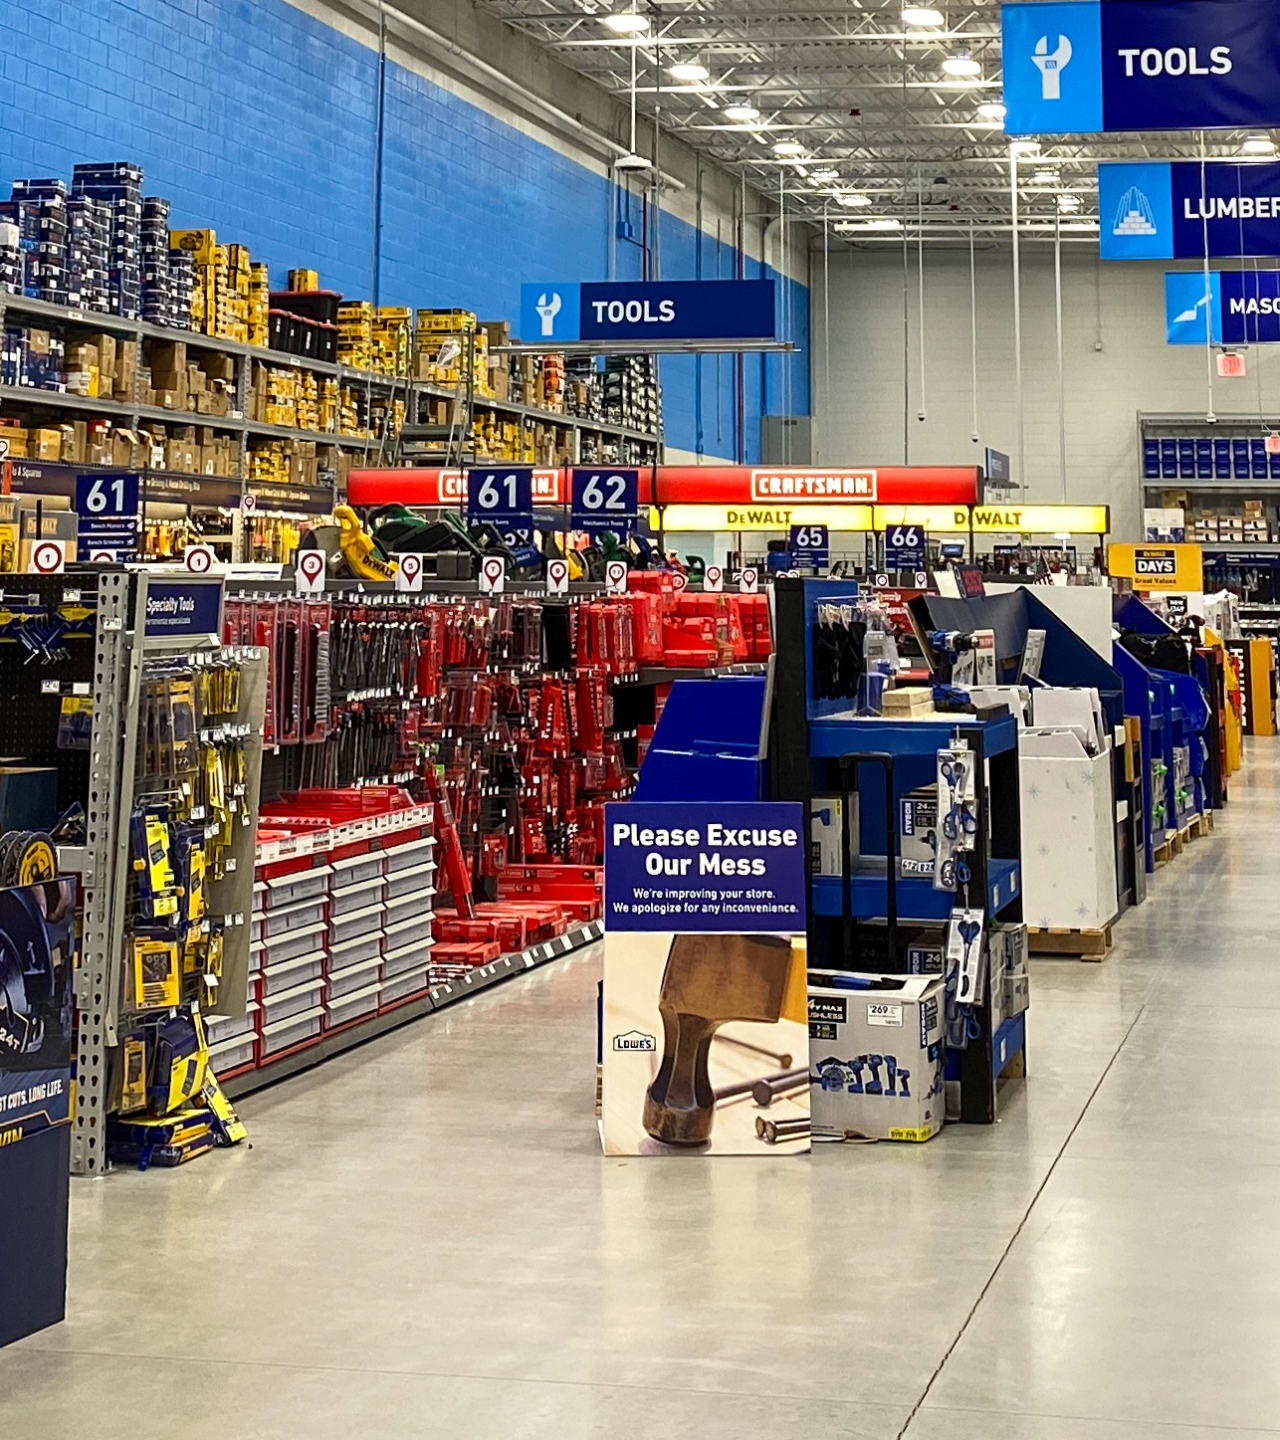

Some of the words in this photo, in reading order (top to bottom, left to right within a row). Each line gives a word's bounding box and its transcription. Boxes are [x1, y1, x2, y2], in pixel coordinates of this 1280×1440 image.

[1118, 45, 1233, 77] TOOLS
[592, 299, 676, 323] TOOLS
[86, 479, 125, 512] 61
[478, 474, 517, 509] 61
[582, 475, 627, 509] 62
[759, 477, 869, 494] CRAFTSMAN
[796, 527, 823, 547] 65
[891, 527, 919, 547] 66
[1137, 560, 1173, 573] DAYS
[146, 596, 176, 614] Specialty
[178, 596, 195, 611] Tools
[613, 823, 701, 847] Please
[707, 823, 798, 847] Excuse
[645, 853, 692, 876] Our
[698, 853, 767, 876] Mess
[632, 887, 664, 900] We're
[665, 888, 718, 903] improving
[720, 890, 744, 902] your
[745, 888, 776, 900] store.
[613, 902, 629, 913] We
[631, 902, 682, 916] apologize
[683, 902, 700, 913] for
[701, 904, 720, 916] any
[722, 902, 800, 914] inconvenience.
[617, 1038, 652, 1051] LOWE'S
[7, 1090, 27, 1111] CUTS.
[28, 1085, 46, 1104] LONG
[46, 1079, 64, 1098] LIFE.
